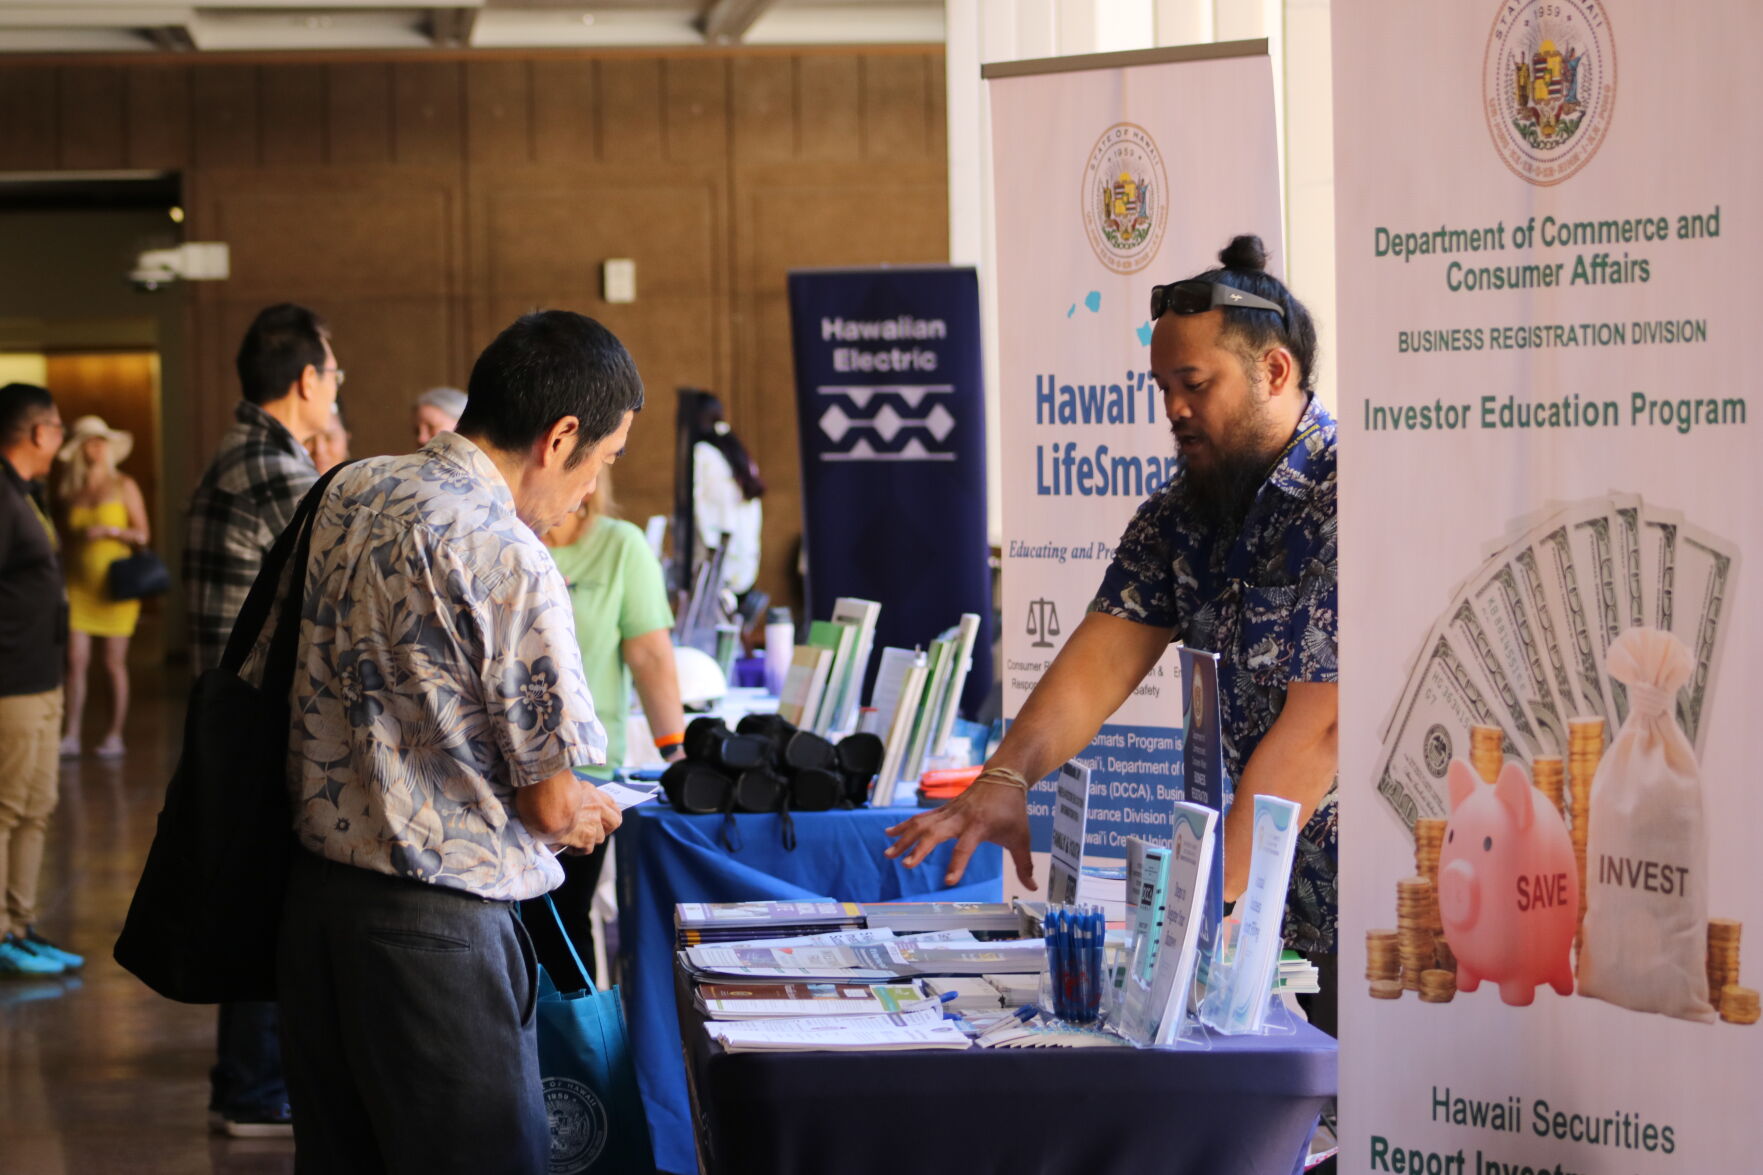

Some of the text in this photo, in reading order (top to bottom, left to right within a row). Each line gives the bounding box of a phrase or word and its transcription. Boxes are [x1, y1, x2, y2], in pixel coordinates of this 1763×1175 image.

[1534, 5, 1561, 19] 1959
[1115, 129, 1129, 138] OF
[1374, 205, 1721, 263] Department of Commerce and
[1446, 252, 1651, 292] Consumer Affairs
[820, 316, 946, 341] Hawaiian
[1398, 319, 1708, 353] BUSINESS REGISTRATION DIVISION
[833, 347, 937, 372] Electric
[1363, 391, 1747, 434] Investor Education Program
[1036, 442, 1178, 497] LifeSmar
[1009, 540, 1068, 564] Educating
[1071, 541, 1094, 559] and
[1007, 659, 1041, 672] Consumer
[1127, 733, 1173, 752] Program
[1174, 735, 1183, 750] is
[1107, 757, 1169, 778] Department
[1171, 760, 1181, 774] of
[1088, 783, 1107, 797] airs
[1157, 785, 1185, 802] Busin
[1027, 801, 1049, 817] sion
[1123, 807, 1167, 825] Division
[1599, 853, 1689, 897] INVEST
[1516, 873, 1568, 912] SAVE
[1432, 1085, 1676, 1155] Hawaii Securities
[1370, 1135, 1466, 1175] Report
